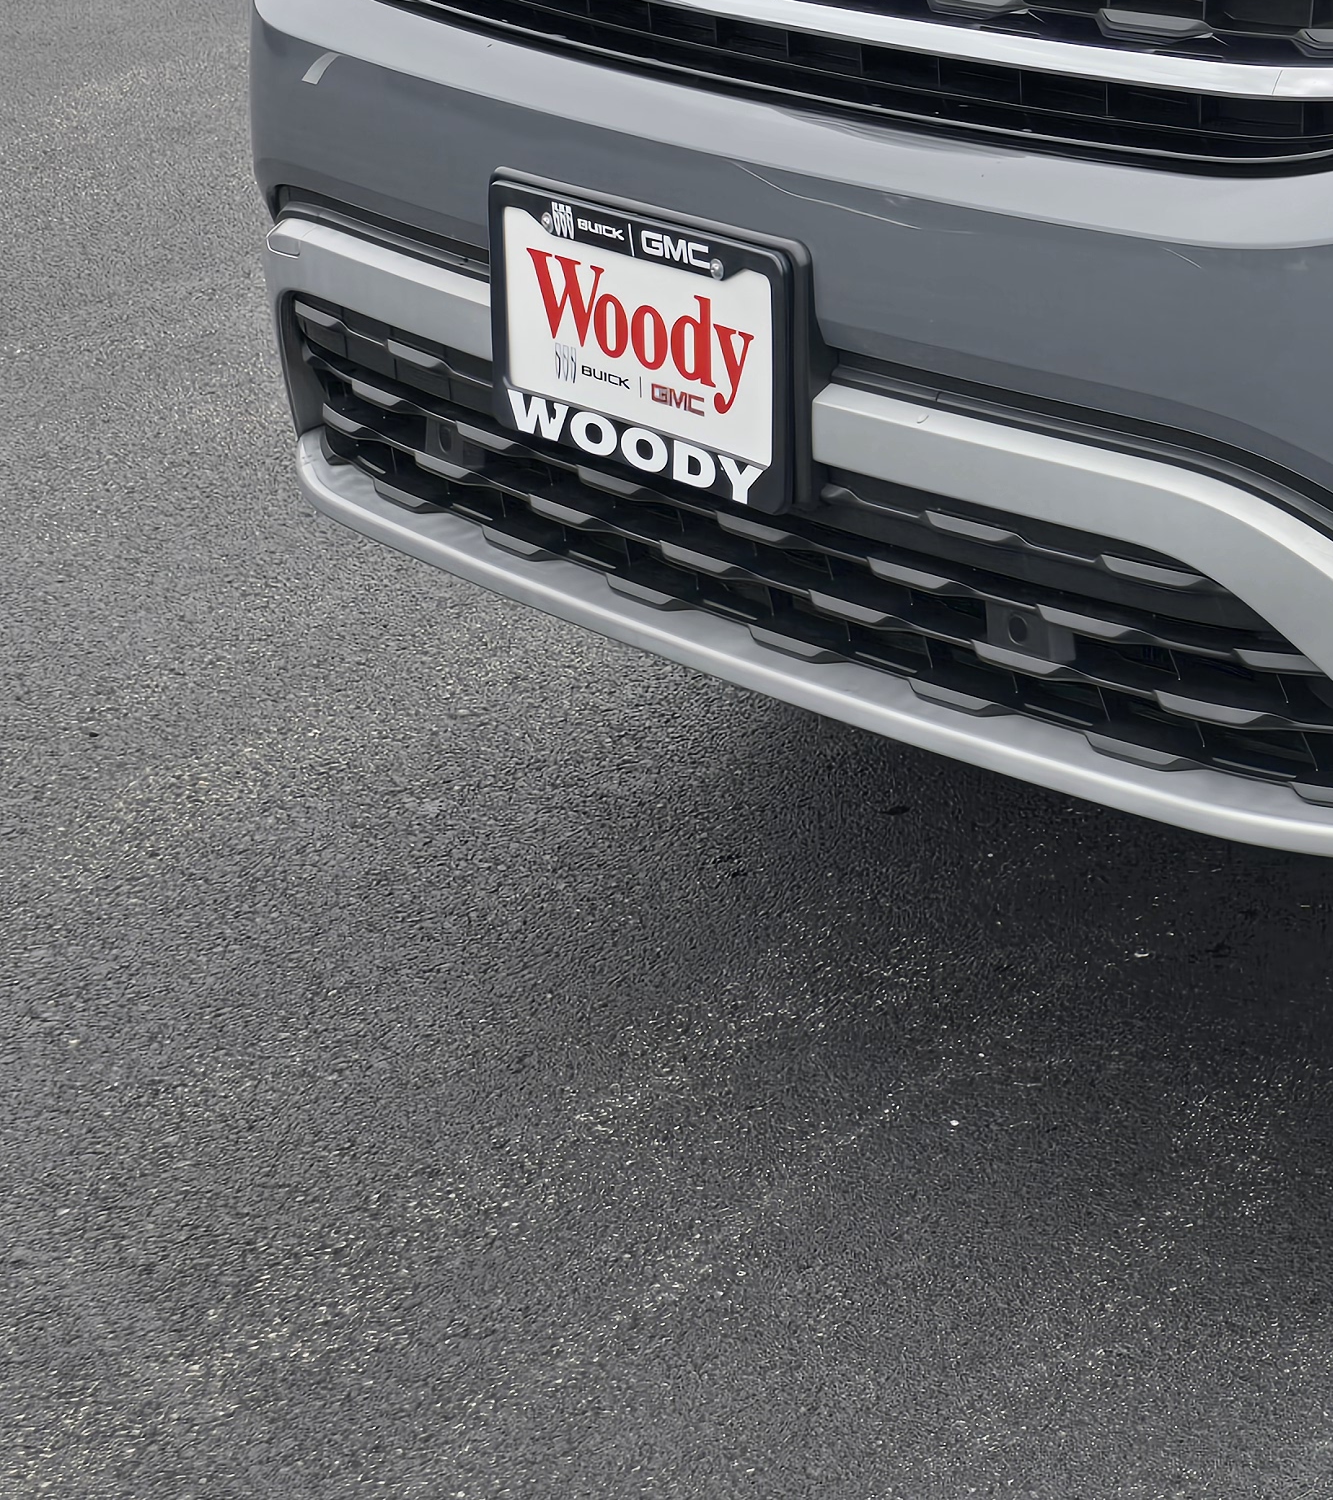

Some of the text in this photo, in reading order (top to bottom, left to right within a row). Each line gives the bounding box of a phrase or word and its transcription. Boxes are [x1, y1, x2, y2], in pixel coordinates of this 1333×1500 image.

[577, 217, 711, 270] BUICK GMC
[526, 247, 755, 415] Woody
[581, 364, 706, 417] BUICK GMC
[507, 388, 765, 506] WOODY
